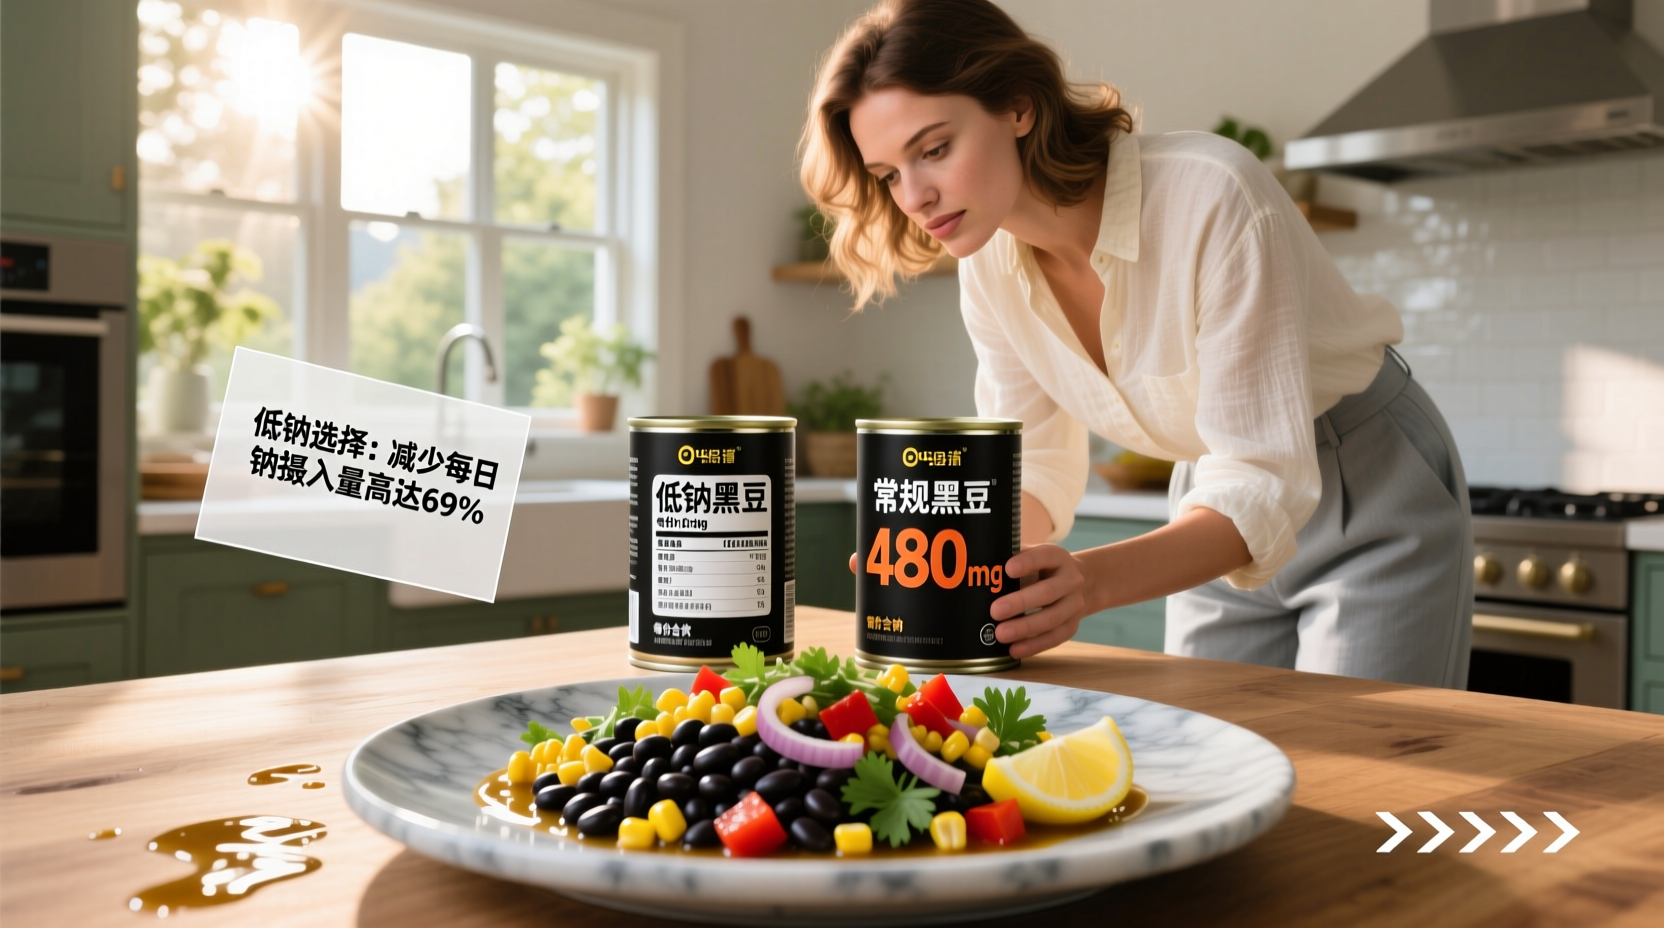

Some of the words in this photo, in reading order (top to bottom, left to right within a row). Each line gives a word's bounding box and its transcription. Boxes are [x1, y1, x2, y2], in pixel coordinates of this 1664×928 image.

[655, 480, 768, 514] 低钠黑豆
[873, 477, 992, 515] 常规黑豆
